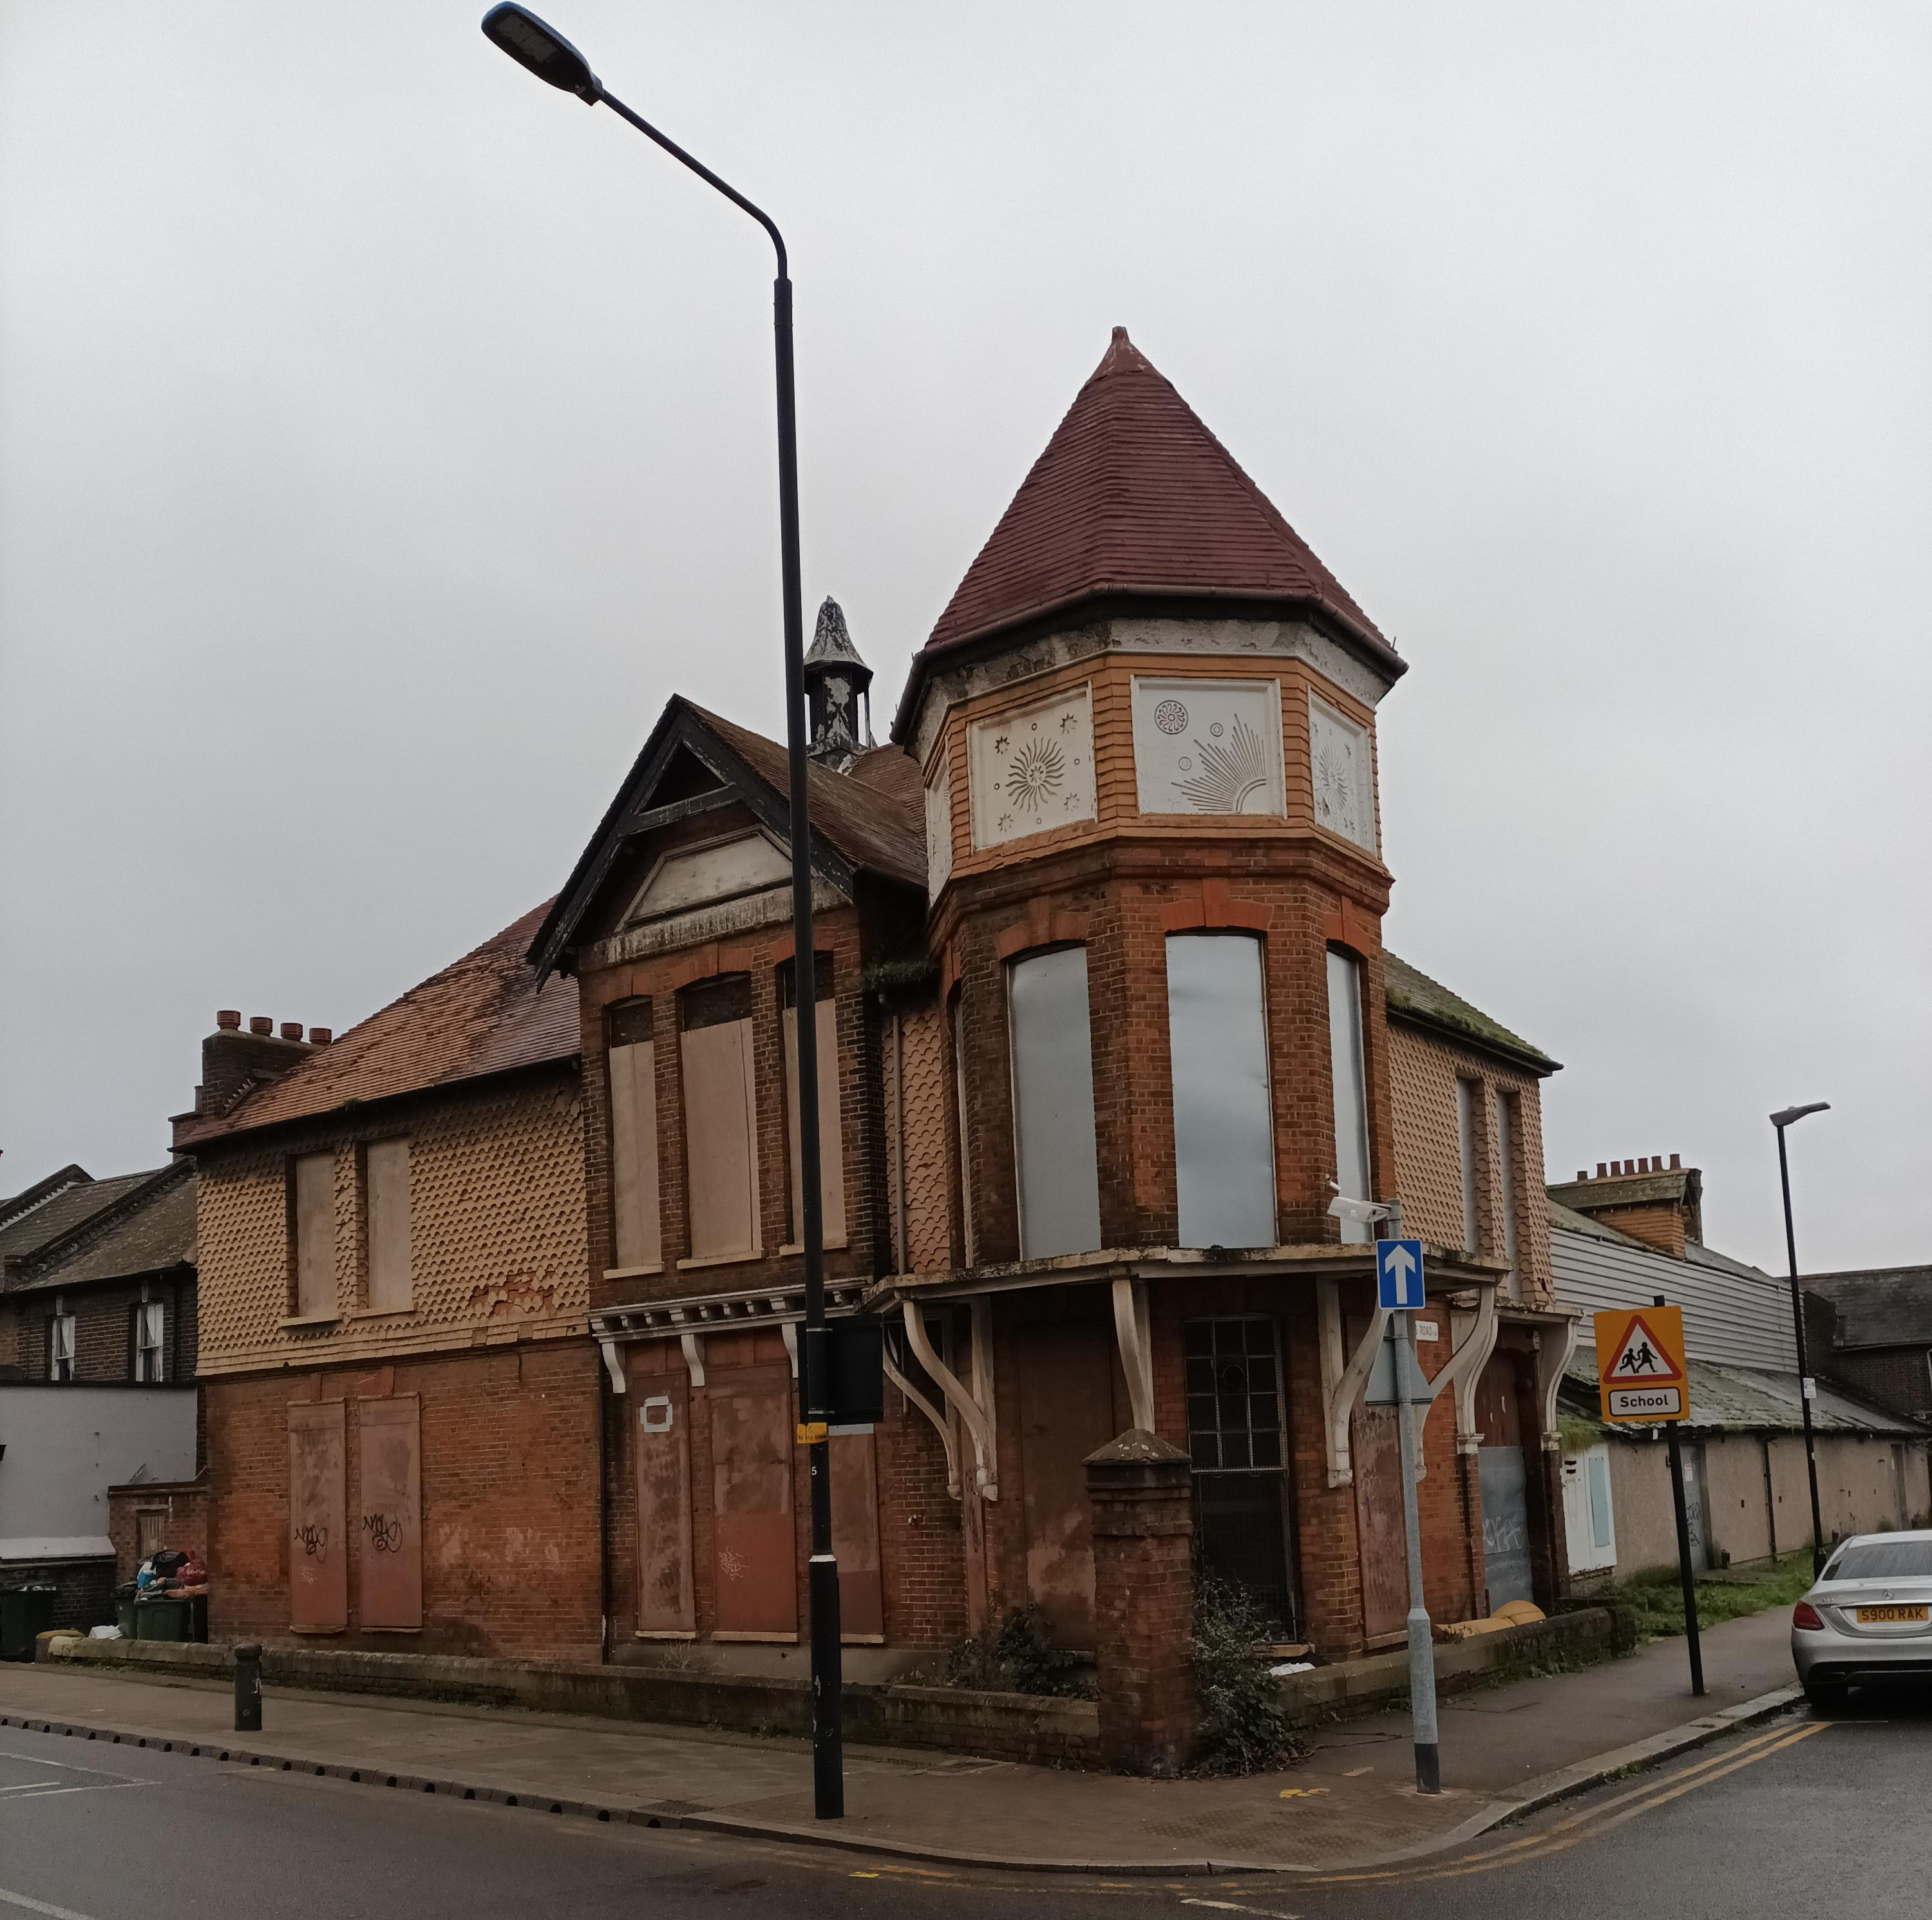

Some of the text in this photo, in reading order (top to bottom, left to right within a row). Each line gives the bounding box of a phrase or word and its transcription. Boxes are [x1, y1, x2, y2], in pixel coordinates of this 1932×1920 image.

[1420, 1326, 1432, 1336] ROAD
[1620, 1394, 1668, 1407] School
[811, 1467, 817, 1476] 5
[1862, 1608, 1923, 1621] S900 RAK
